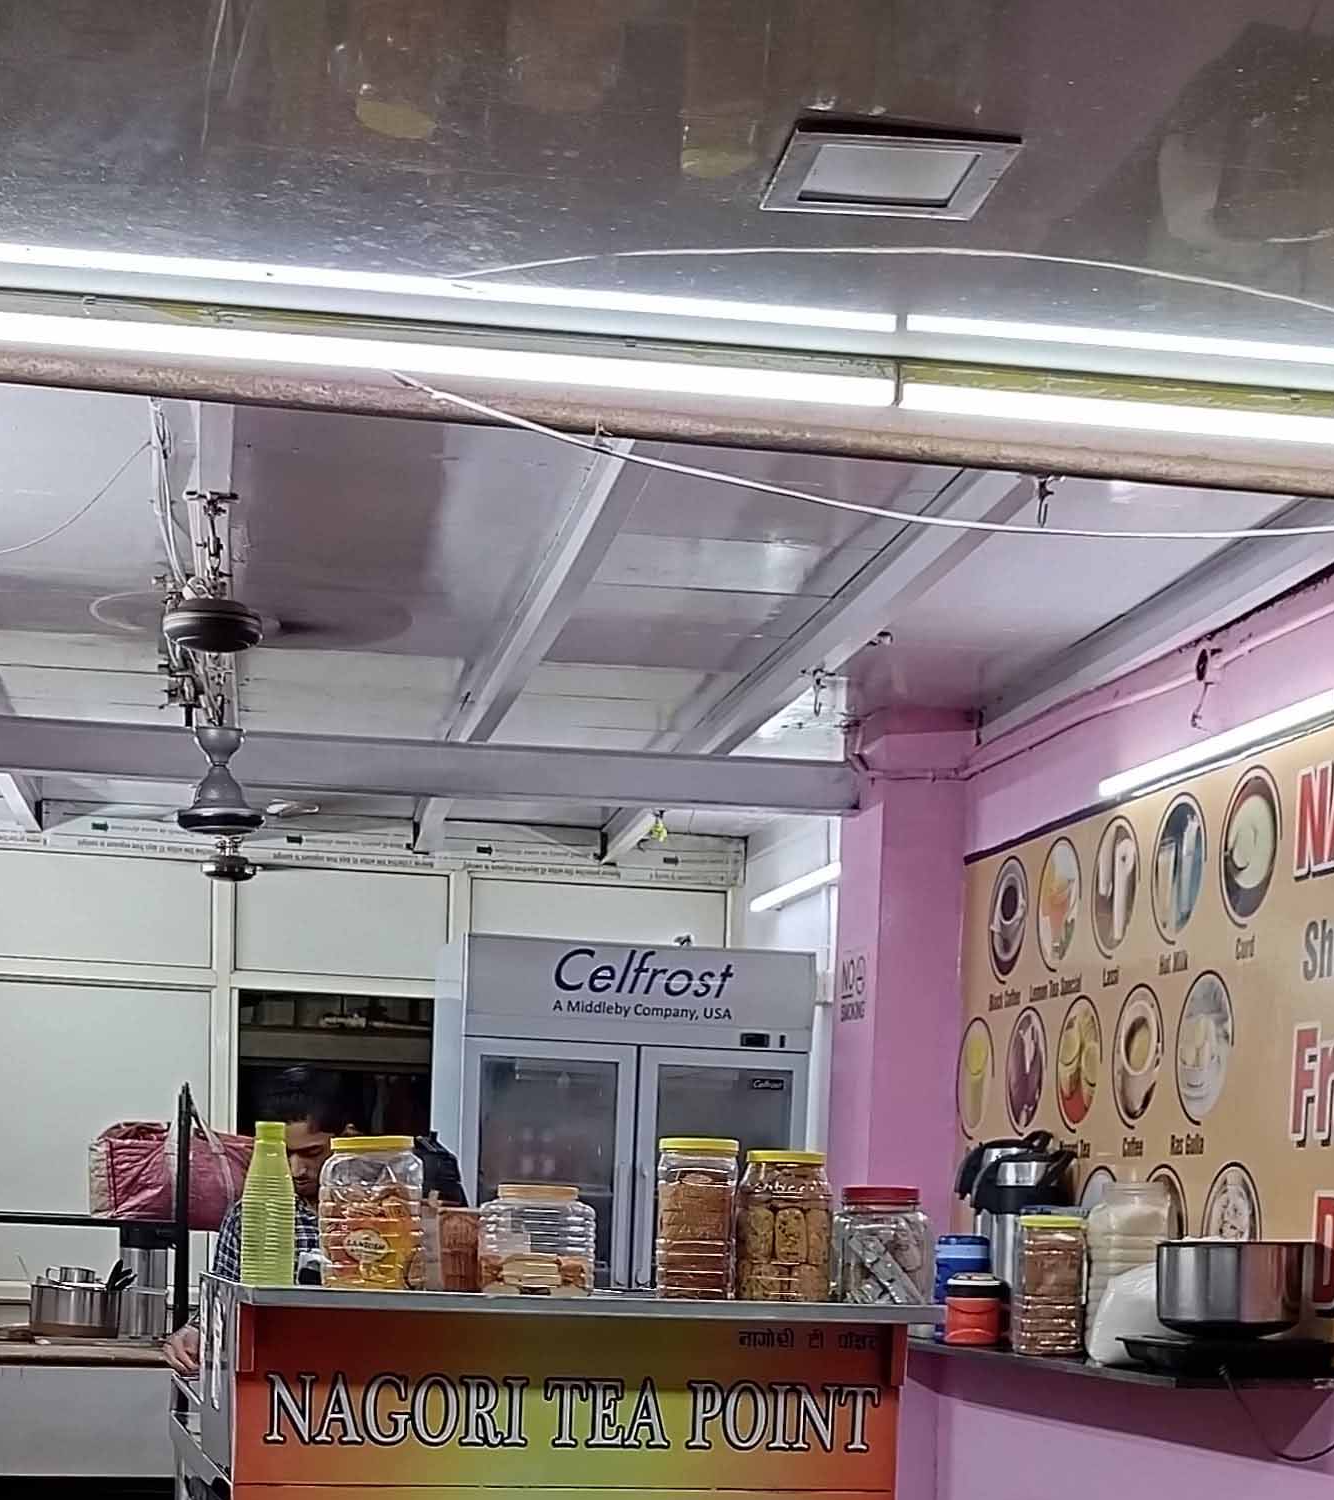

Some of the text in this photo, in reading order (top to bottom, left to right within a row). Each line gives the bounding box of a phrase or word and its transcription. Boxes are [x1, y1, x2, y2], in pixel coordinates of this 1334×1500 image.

[554, 948, 734, 999] Celfrost
[1102, 966, 1120, 987] Lassi
[553, 1000, 732, 1021] A Middleby Company, USA
[264, 1370, 881, 1454] NAGORI TEA POINT
